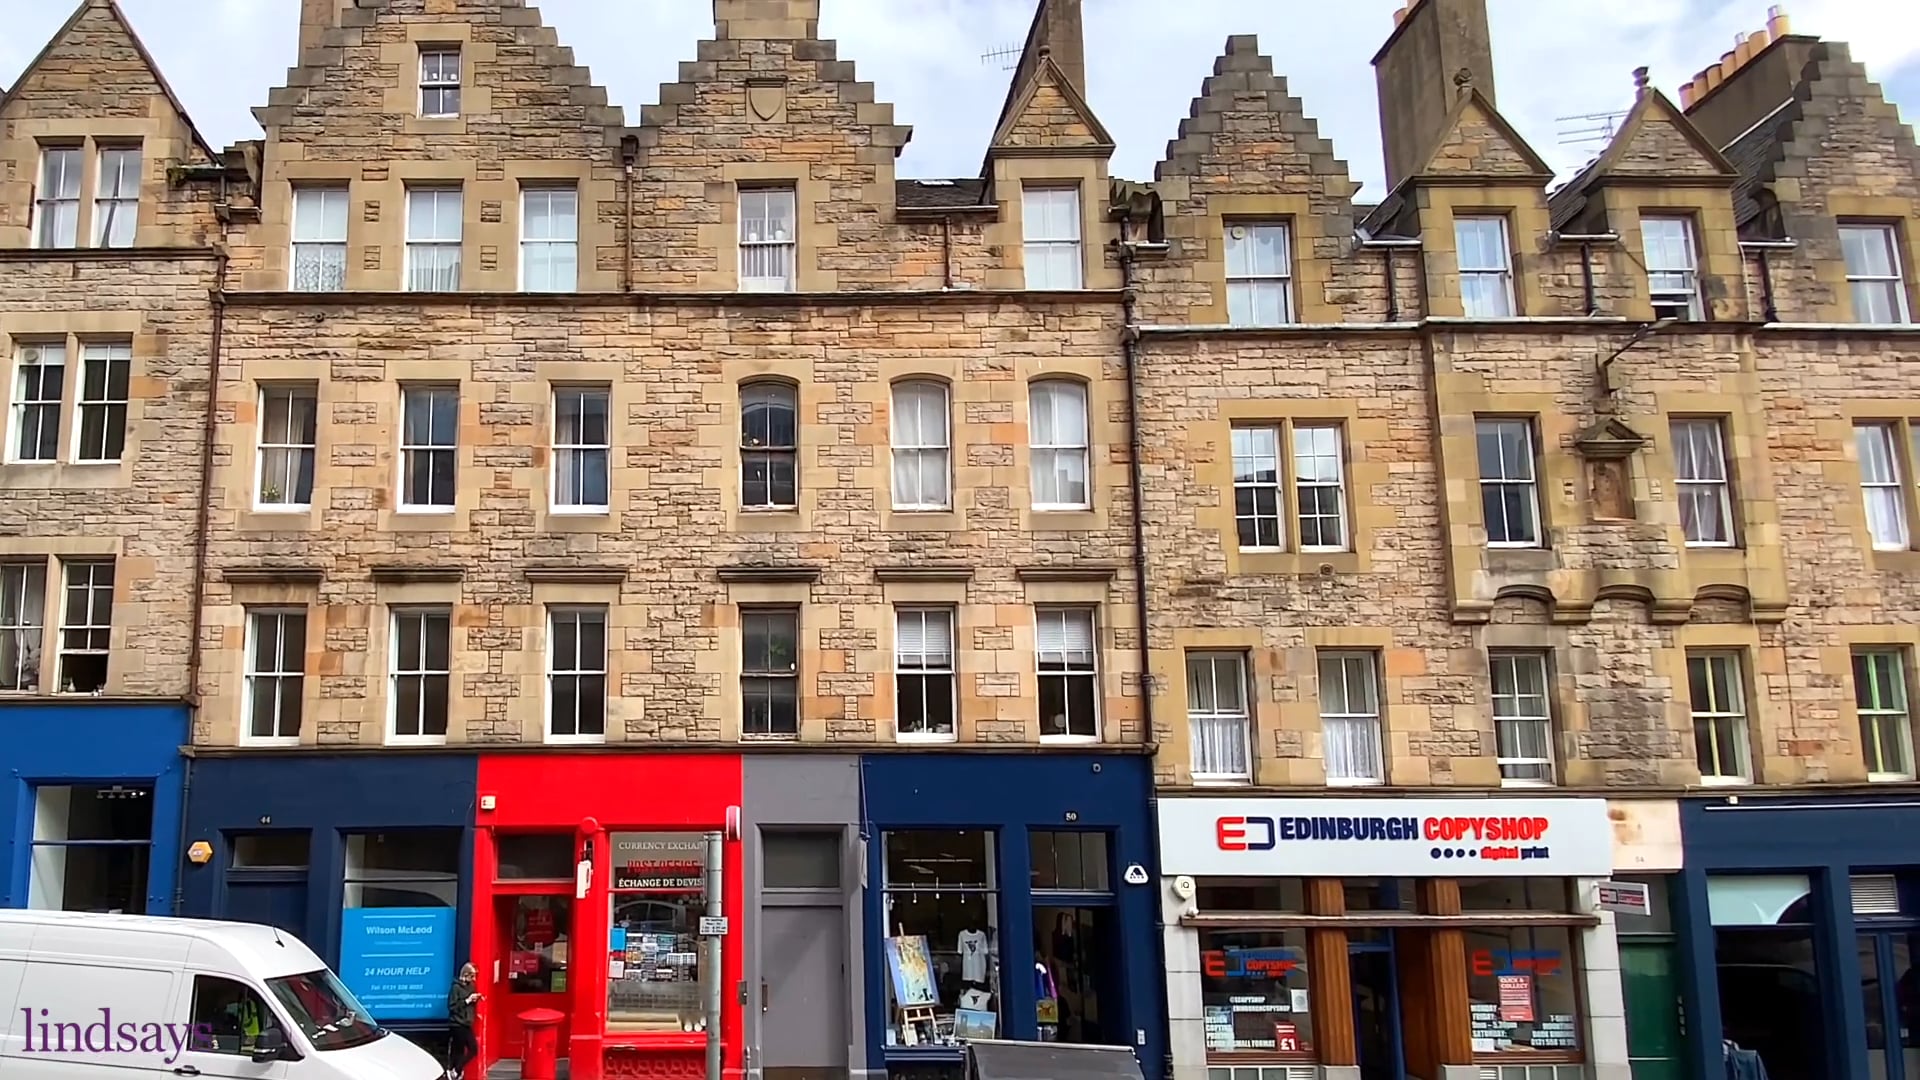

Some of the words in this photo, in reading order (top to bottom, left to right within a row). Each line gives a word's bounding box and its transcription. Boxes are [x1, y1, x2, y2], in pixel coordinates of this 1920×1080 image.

[1065, 812, 1077, 821] 50
[1280, 816, 1419, 841] EDINBURGH
[1423, 816, 1549, 841] COPYSHOP
[618, 841, 665, 850] CURRENCY
[618, 877, 661, 888] ÉCHANGE
[662, 878, 676, 887] DE
[366, 925, 397, 935] Wilson
[397, 925, 433, 934] McLeod
[364, 967, 375, 976] 24
[376, 967, 404, 976] HOUR
[405, 966, 431, 975] HELP
[1280, 1037, 1297, 1051] £1
